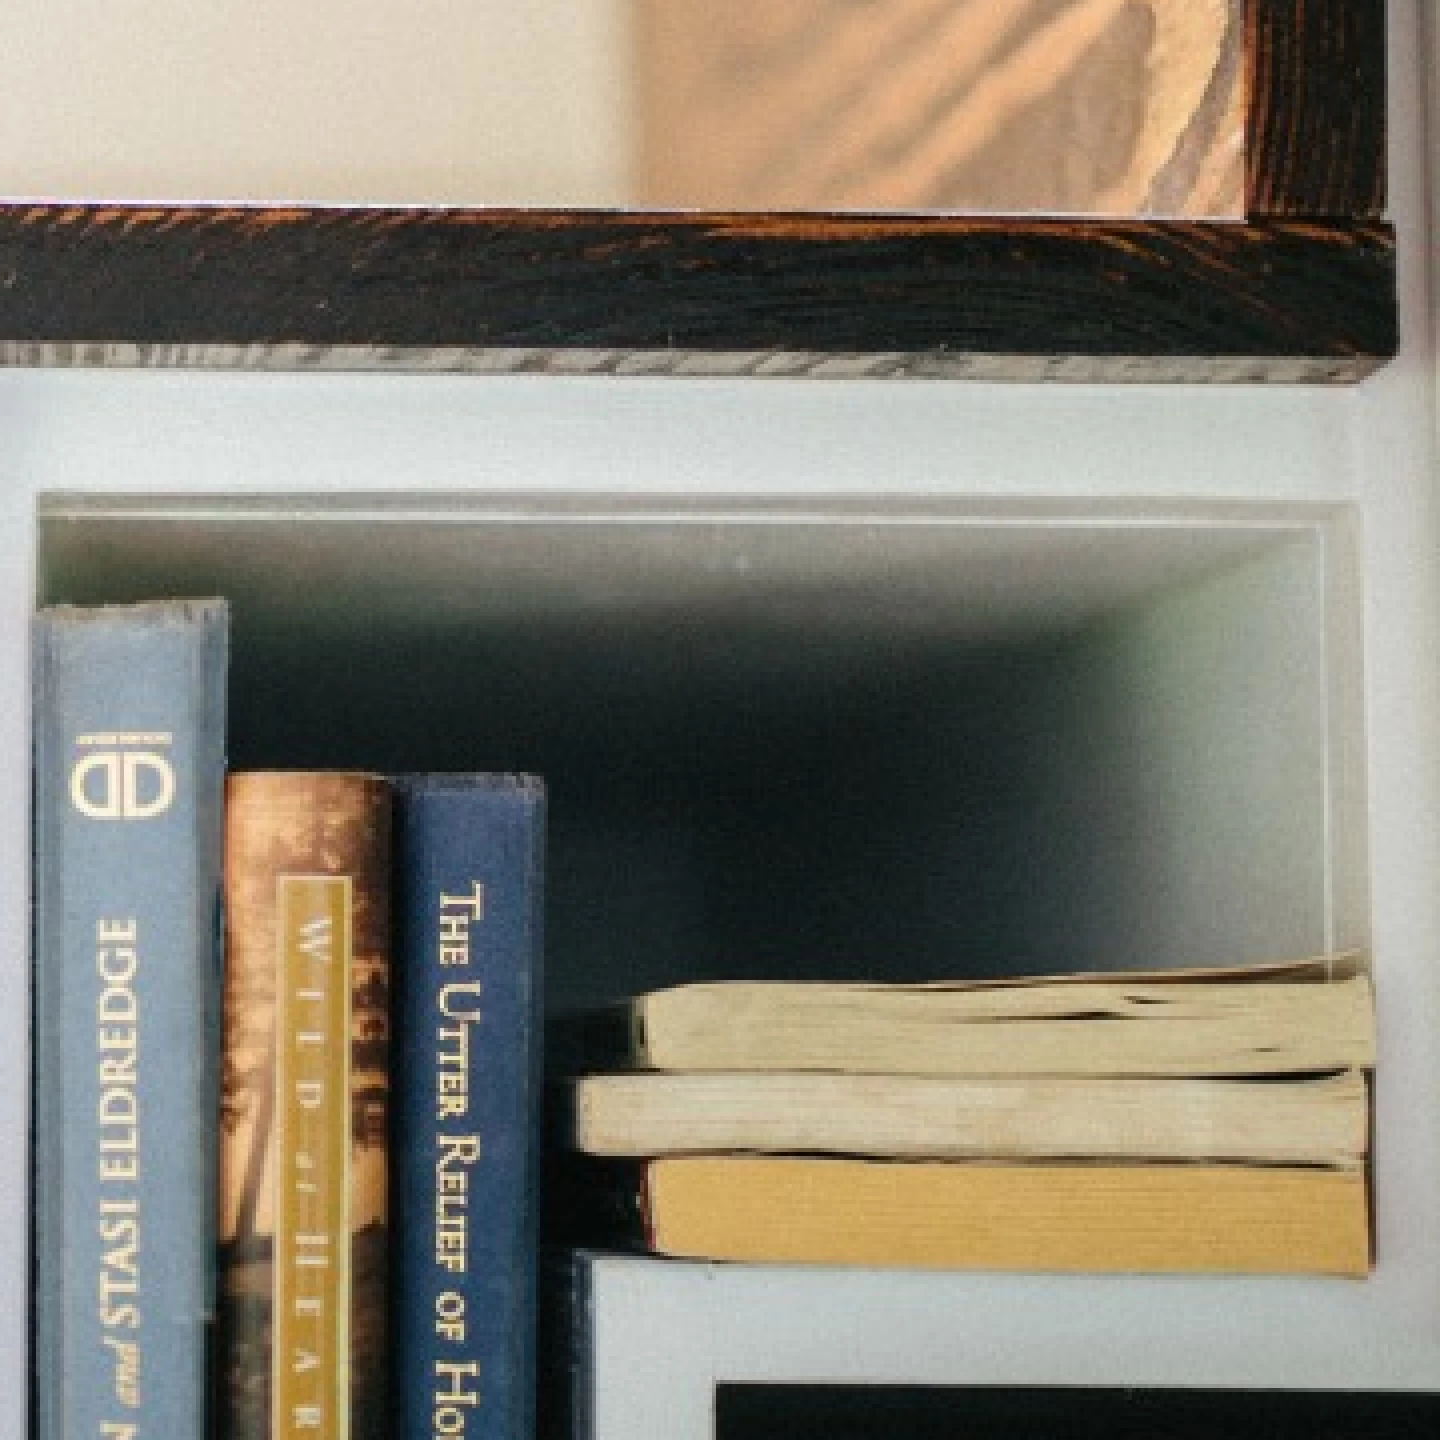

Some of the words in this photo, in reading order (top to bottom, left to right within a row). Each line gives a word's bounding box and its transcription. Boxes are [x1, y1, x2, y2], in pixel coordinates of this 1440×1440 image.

[438, 880, 484, 966] THE
[95, 916, 140, 1183] ELDREDGE
[295, 916, 334, 1110] WILD
[435, 979, 482, 1121] UTTER
[98, 1198, 141, 1329] STASI
[435, 1135, 481, 1274] RELIEF
[101, 1335, 141, 1409] and
[435, 1290, 466, 1342] OF
